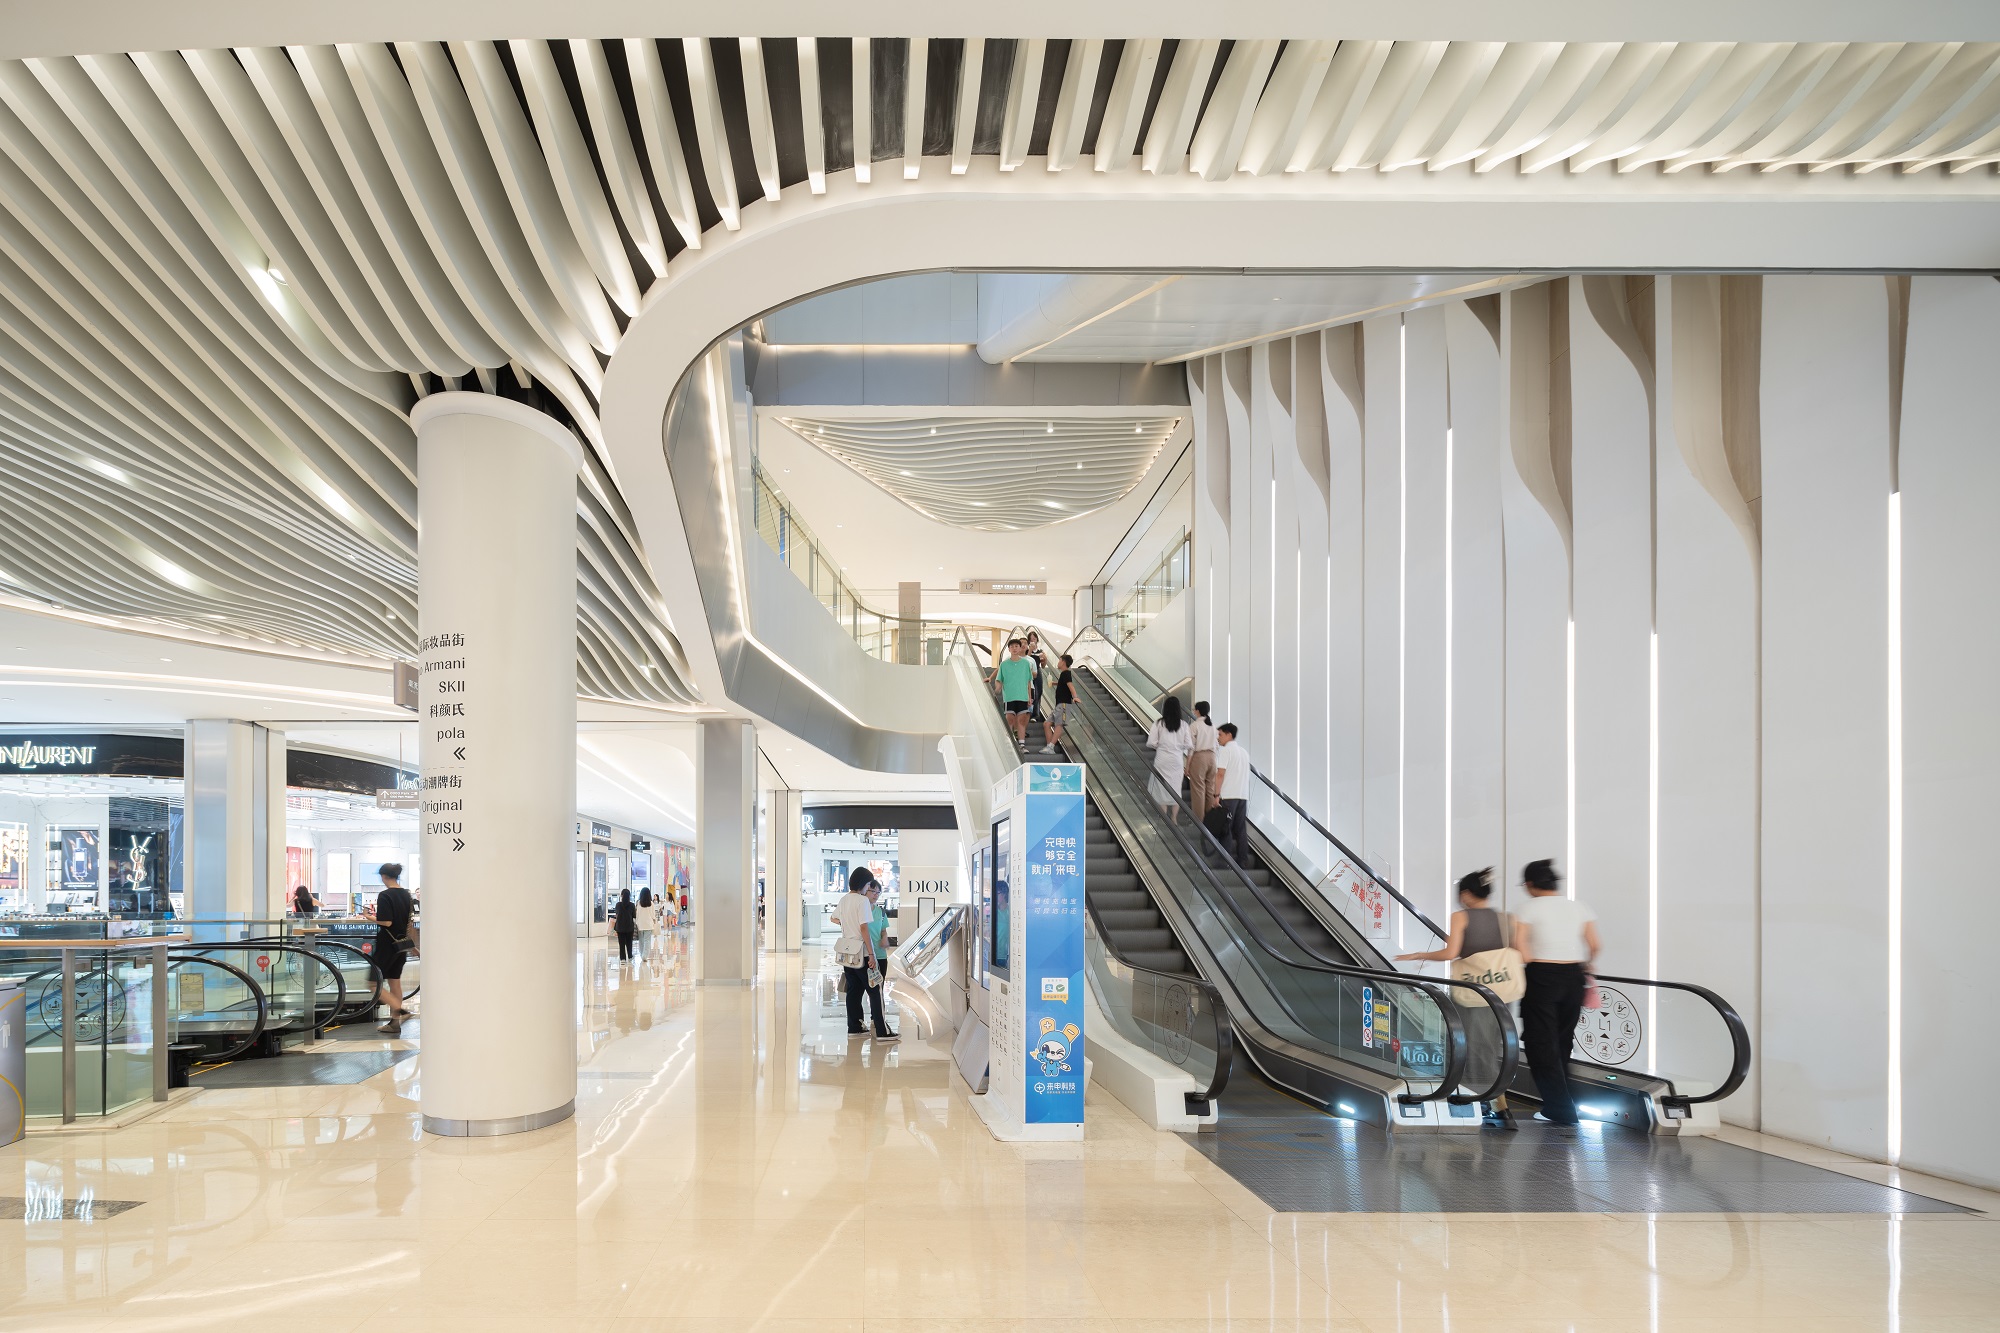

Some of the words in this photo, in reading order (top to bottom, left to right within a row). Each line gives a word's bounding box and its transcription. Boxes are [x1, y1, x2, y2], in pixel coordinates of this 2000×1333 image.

[424, 657, 465, 673] Armani
[429, 702, 465, 718] 科颜氏
[437, 726, 465, 743] pola
[421, 799, 462, 814] Original
[427, 822, 462, 835] EVISU
[1045, 837, 1077, 848] 充电快
[1045, 850, 1077, 861] 够安全
[908, 880, 950, 893] DIOR
[1598, 1018, 1611, 1032] L1
[1046, 1082, 1076, 1091] 来电科技
